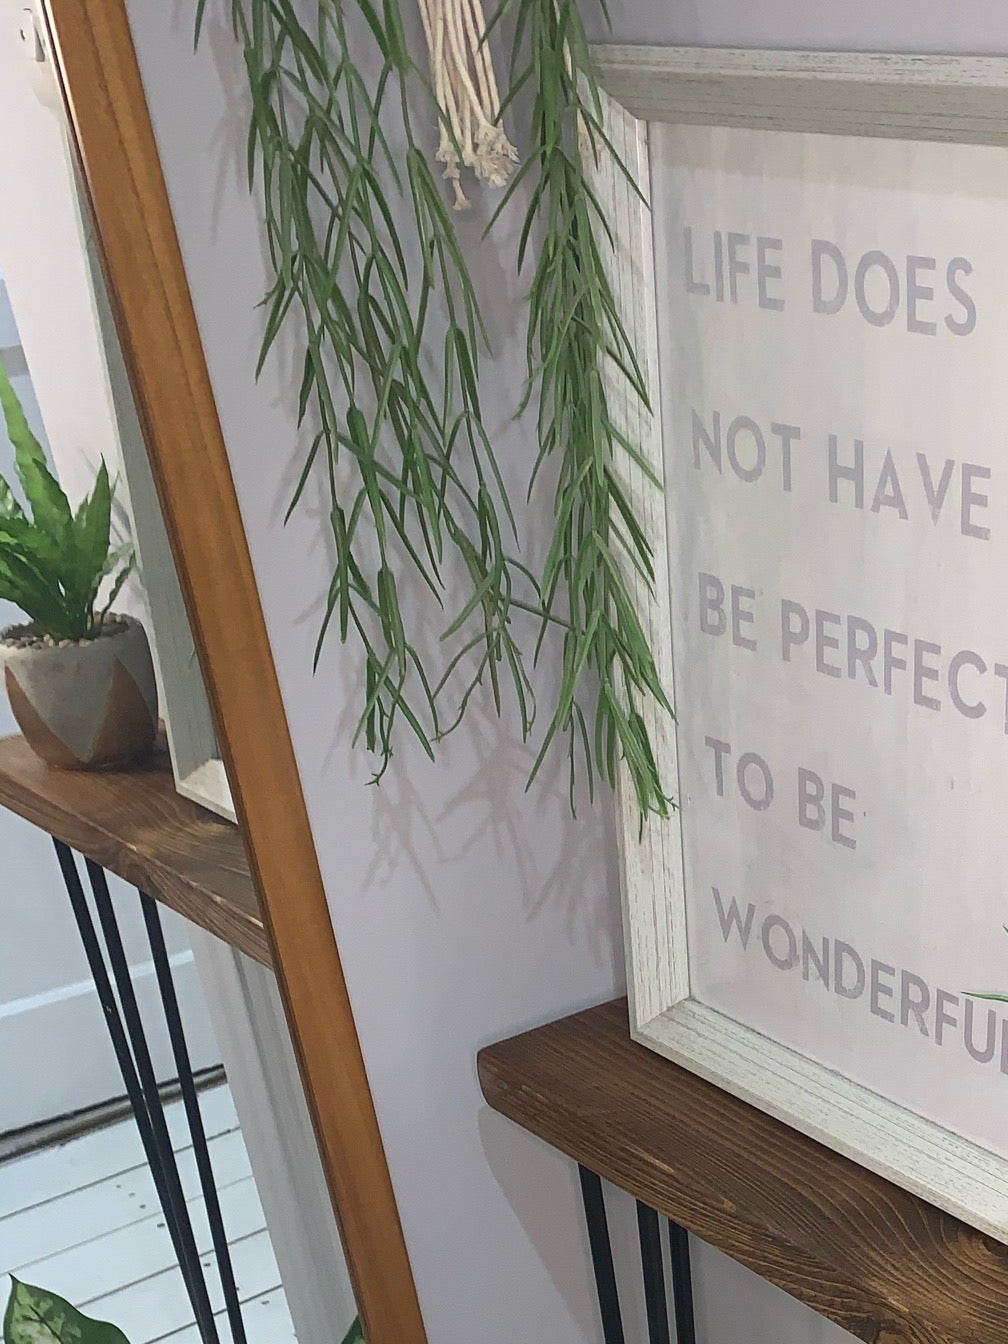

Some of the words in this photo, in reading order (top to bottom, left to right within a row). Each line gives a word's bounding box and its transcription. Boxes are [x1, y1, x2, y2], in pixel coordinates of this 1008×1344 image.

[683, 226, 785, 312] LIFE
[811, 239, 977, 337] DOES
[691, 408, 801, 493] NOT
[828, 434, 992, 542] HAVE
[698, 572, 757, 652] BE
[704, 736, 774, 812] TO
[797, 767, 857, 850] BE
